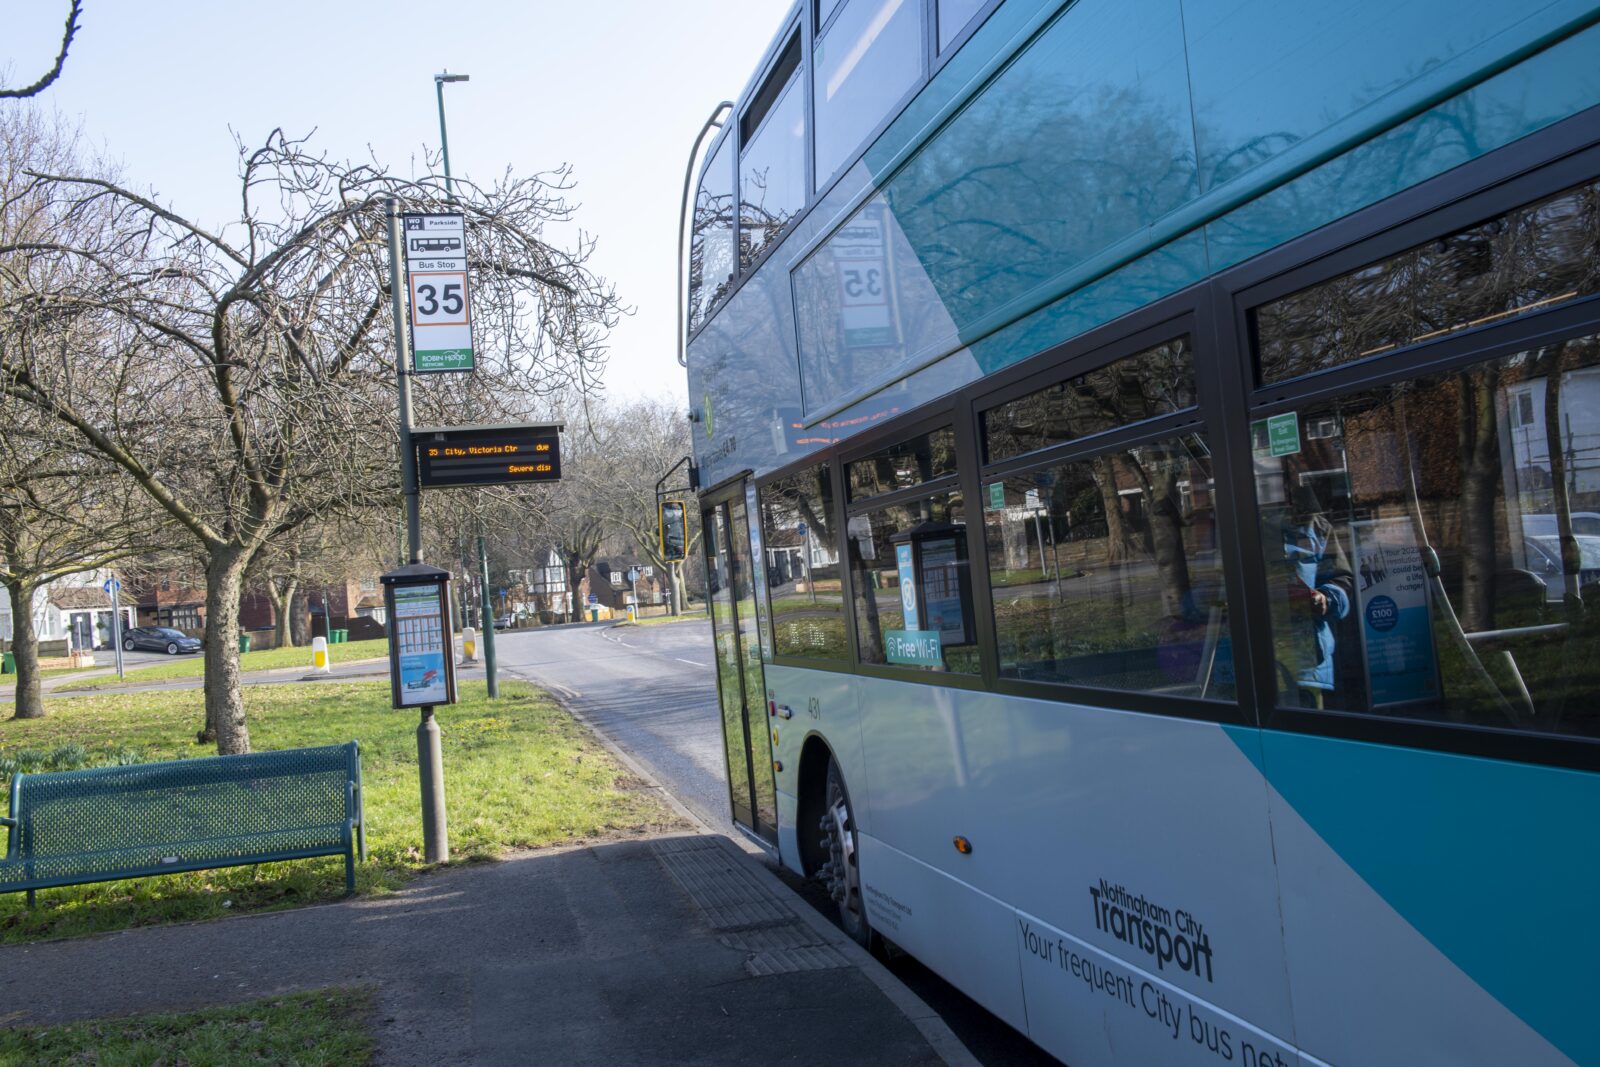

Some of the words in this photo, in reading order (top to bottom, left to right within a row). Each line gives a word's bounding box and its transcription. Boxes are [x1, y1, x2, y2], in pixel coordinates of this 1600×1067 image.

[419, 261, 434, 269] Bus
[437, 261, 456, 269] Stop
[417, 284, 464, 315] 35
[445, 447, 466, 456] City,
[469, 446, 502, 455] Victoria
[504, 445, 518, 453] Ctr
[509, 465, 534, 473] Severe
[1392, 564, 1412, 574] could
[1372, 608, 1392, 619] £100
[896, 637, 916, 658] Free
[916, 638, 939, 660] Wi-Fi
[808, 696, 820, 720] 431
[1099, 878, 1172, 926] Nottingham
[1175, 909, 1203, 947] City
[1089, 886, 1213, 983] Transport
[1019, 919, 1053, 963] Your
[1057, 939, 1136, 1009] frequent
[1141, 981, 1181, 1039] City
[1188, 1004, 1232, 1060] bus
